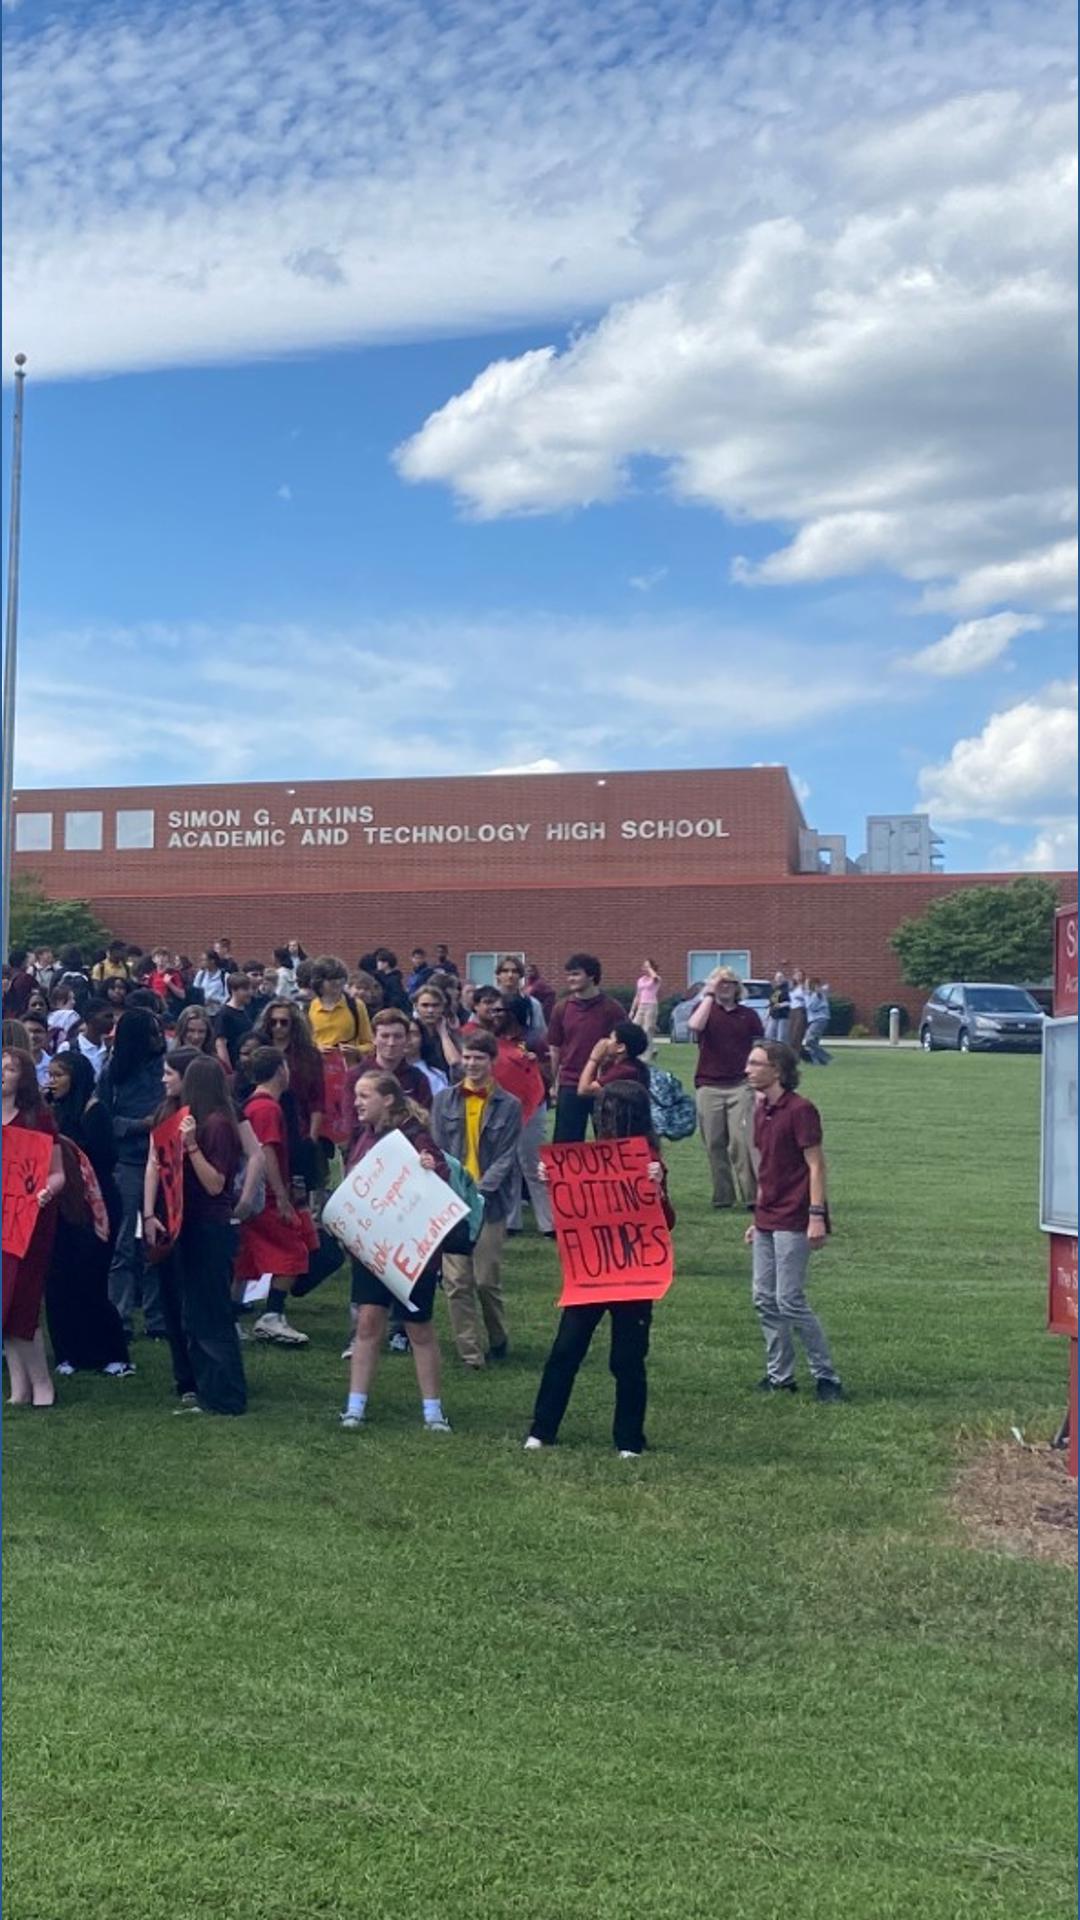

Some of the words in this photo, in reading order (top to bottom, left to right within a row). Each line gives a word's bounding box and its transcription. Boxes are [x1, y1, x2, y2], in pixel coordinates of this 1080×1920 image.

[167, 829, 286, 849] ACADEMIC
[301, 827, 349, 846] AND
[363, 822, 531, 845] TECHNOLOGY
[546, 821, 606, 841] HIGH
[621, 818, 730, 840] SCHOOL
[168, 809, 241, 829] SIMON
[253, 809, 276, 826] G.
[289, 806, 374, 825] ATKINS
[553, 1176, 656, 1218] CUTTING
[393, 1200, 462, 1281] Education
[563, 1222, 668, 1279] FUTURES
